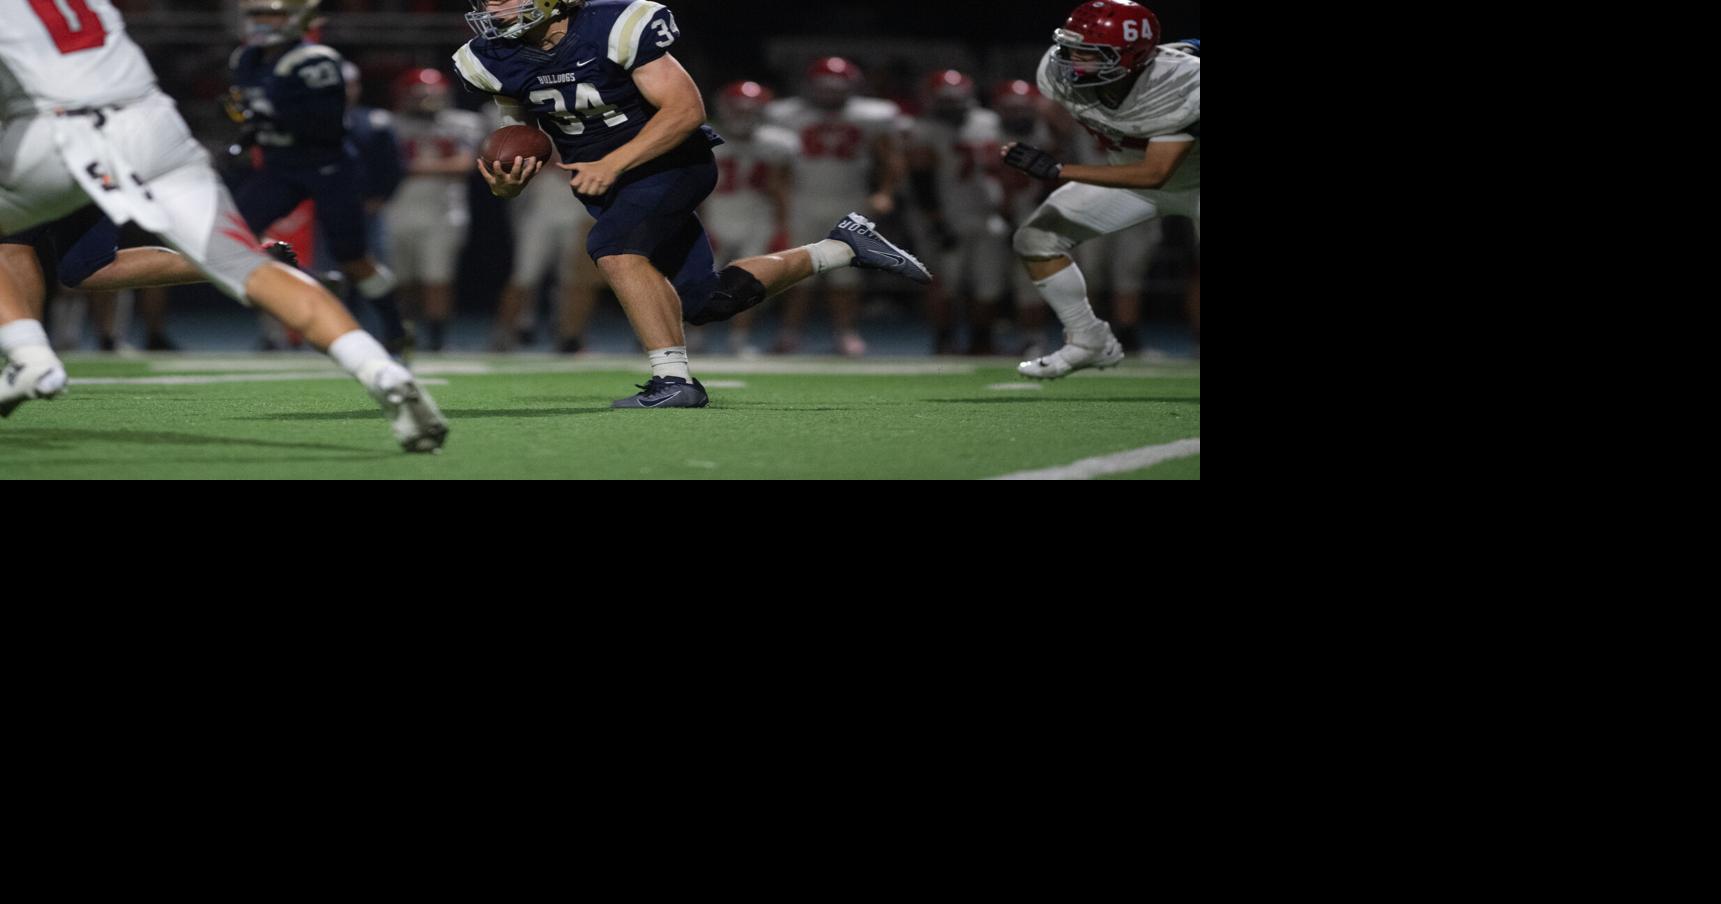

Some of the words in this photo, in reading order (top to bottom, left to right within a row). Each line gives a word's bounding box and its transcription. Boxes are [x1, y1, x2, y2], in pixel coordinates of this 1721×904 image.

[1122, 18, 1153, 42] 64
[537, 72, 577, 85] BULLDOGS
[529, 82, 629, 136] 34
